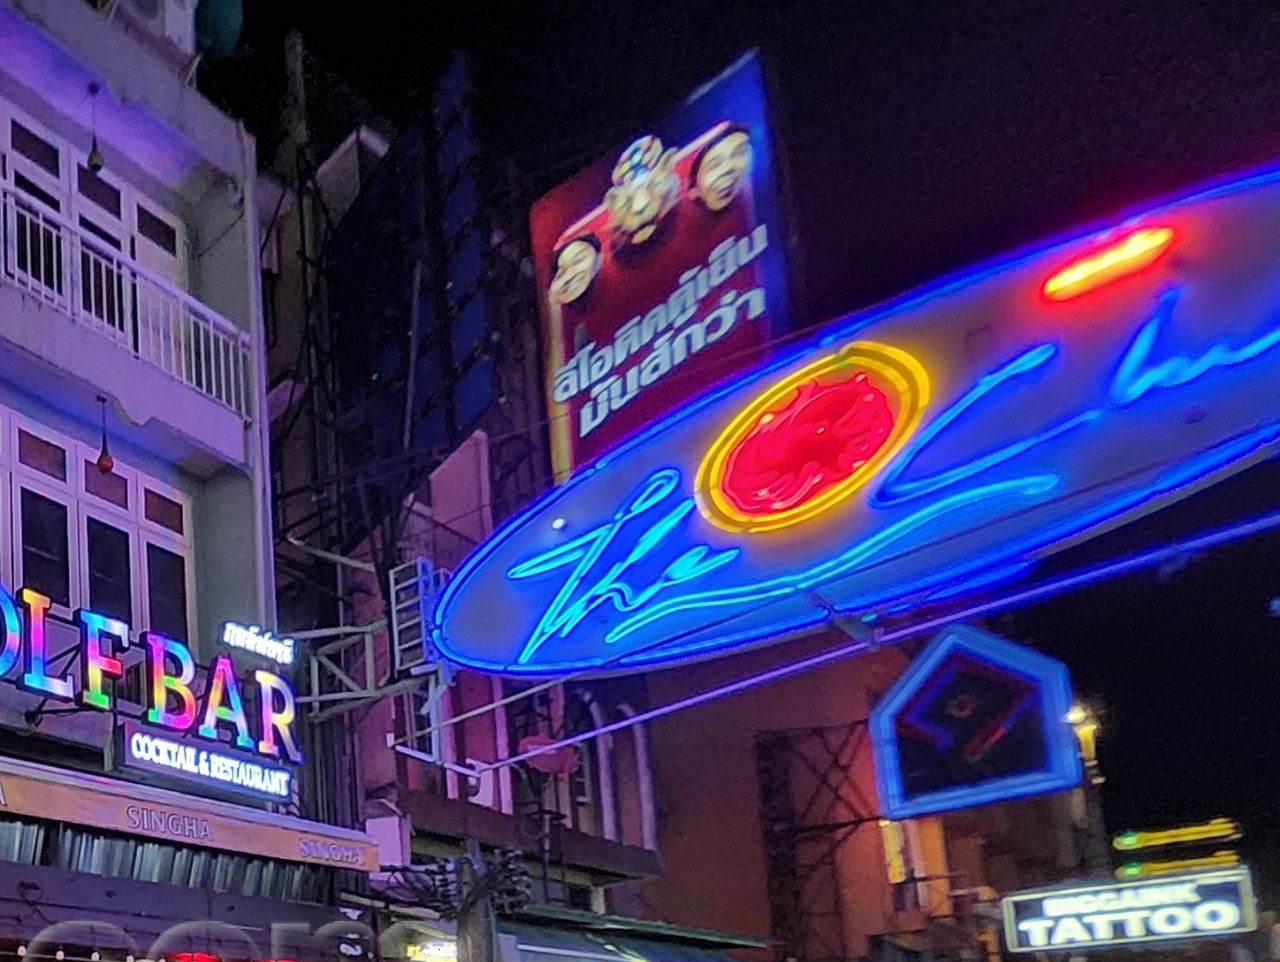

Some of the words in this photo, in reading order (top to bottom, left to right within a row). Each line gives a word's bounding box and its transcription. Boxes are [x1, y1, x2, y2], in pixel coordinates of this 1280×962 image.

[143, 629, 305, 765] BAR
[131, 732, 198, 774] COCKTAIL
[199, 751, 210, 777] &
[209, 753, 291, 797] RESTAURANT
[126, 804, 214, 842] SINGHA
[297, 838, 364, 866] SINGHA
[1018, 900, 1241, 948] TATTOO
